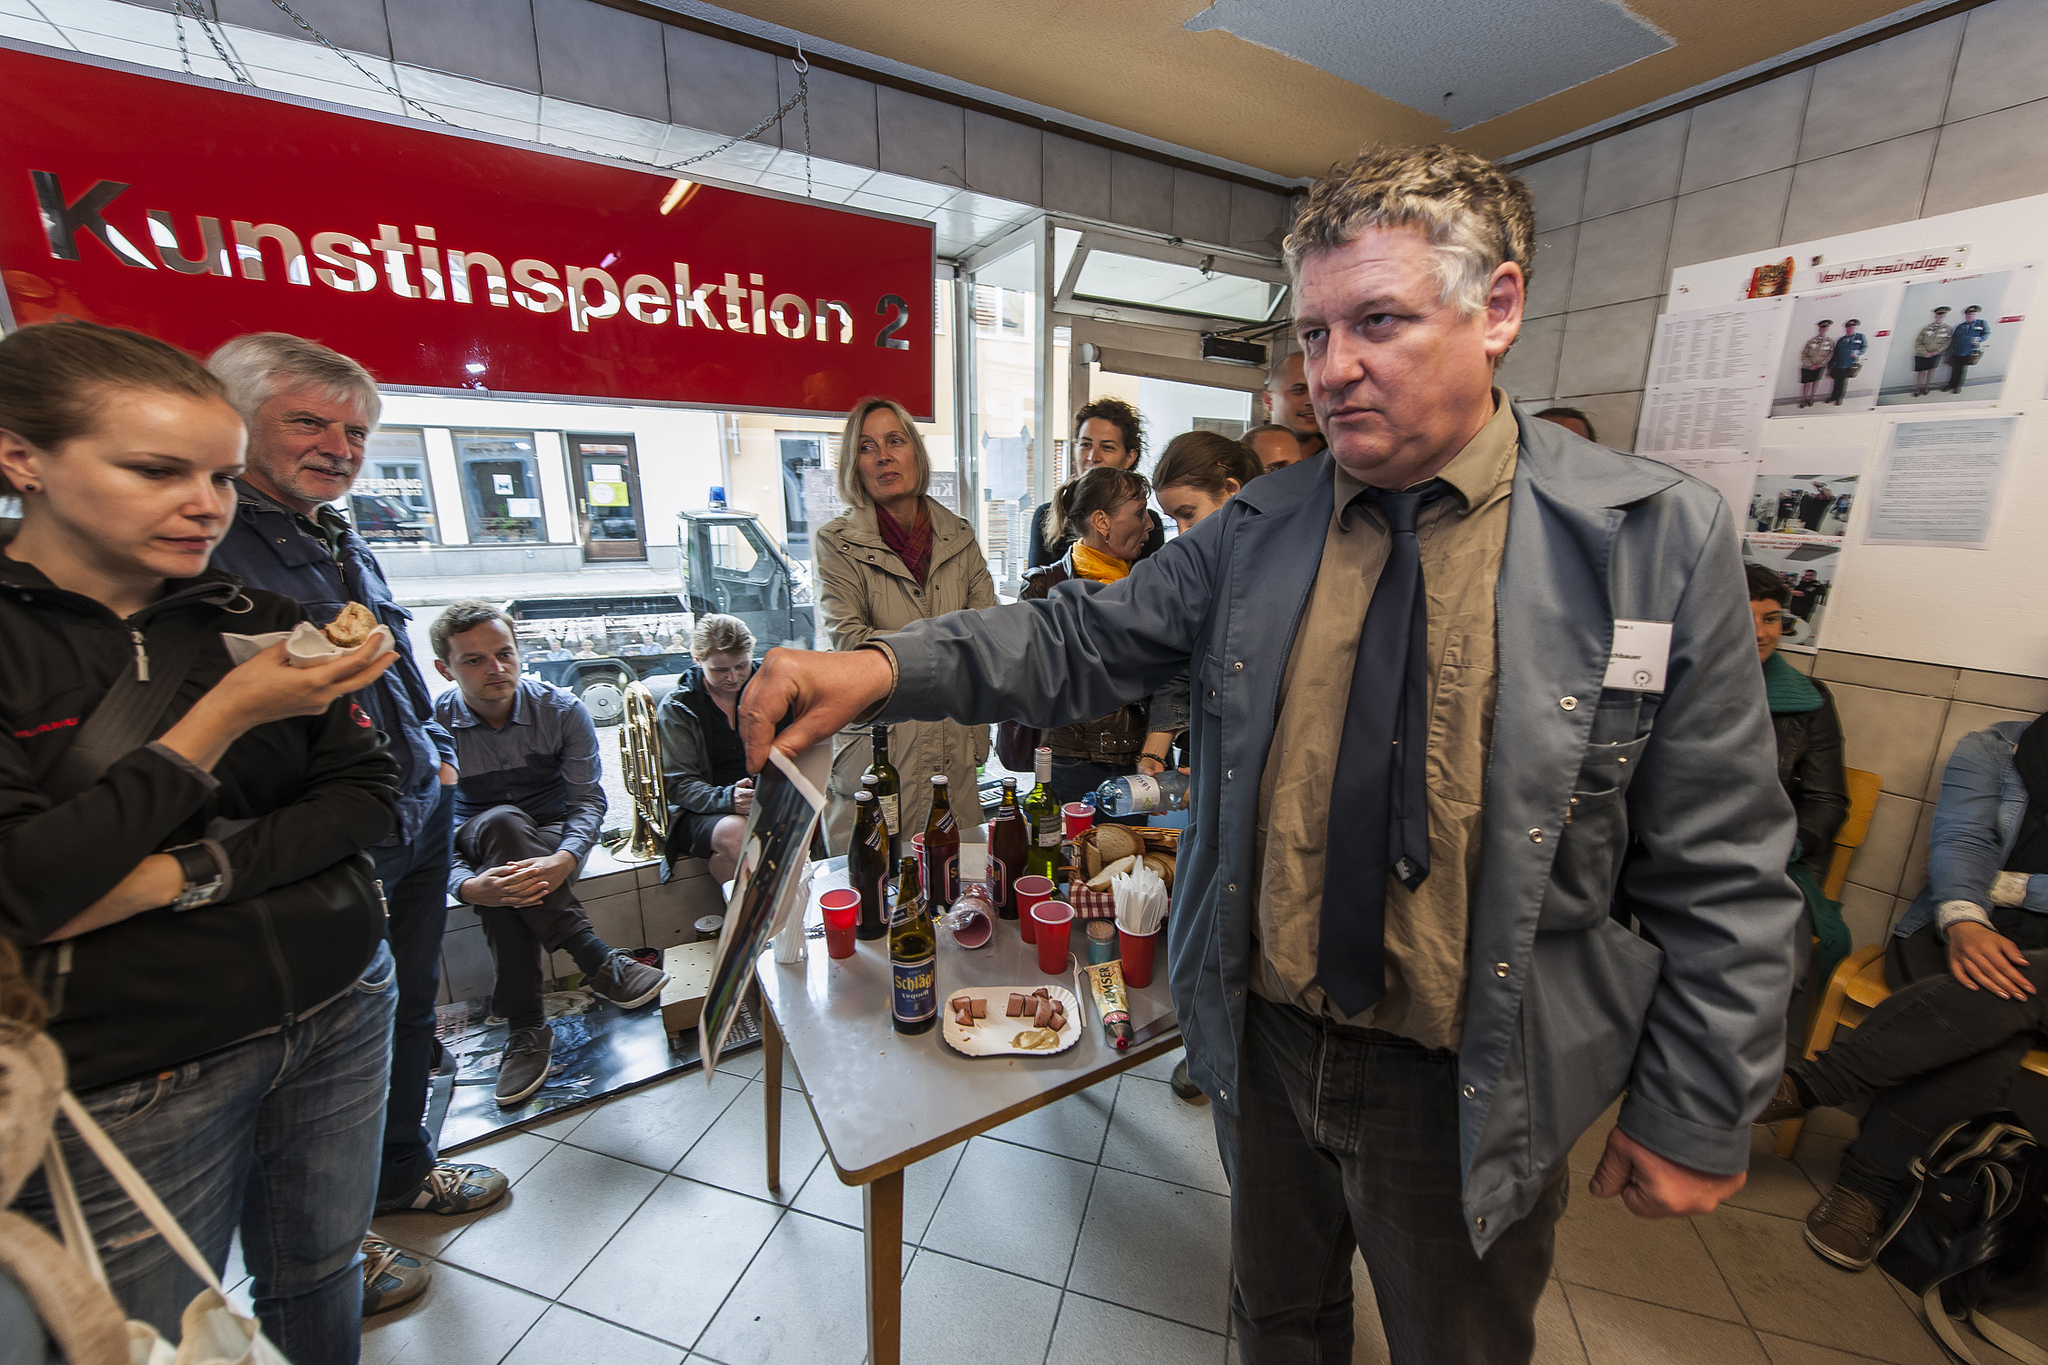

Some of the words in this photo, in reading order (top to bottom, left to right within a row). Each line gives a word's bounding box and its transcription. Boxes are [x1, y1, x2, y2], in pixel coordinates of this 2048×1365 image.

[30, 169, 853, 344] Kunstinspektion
[876, 294, 909, 350] 2
[1819, 255, 1951, 284] Verkehrssündige
[1610, 652, 1642, 660] chbauer
[895, 969, 934, 992] Schlägl
